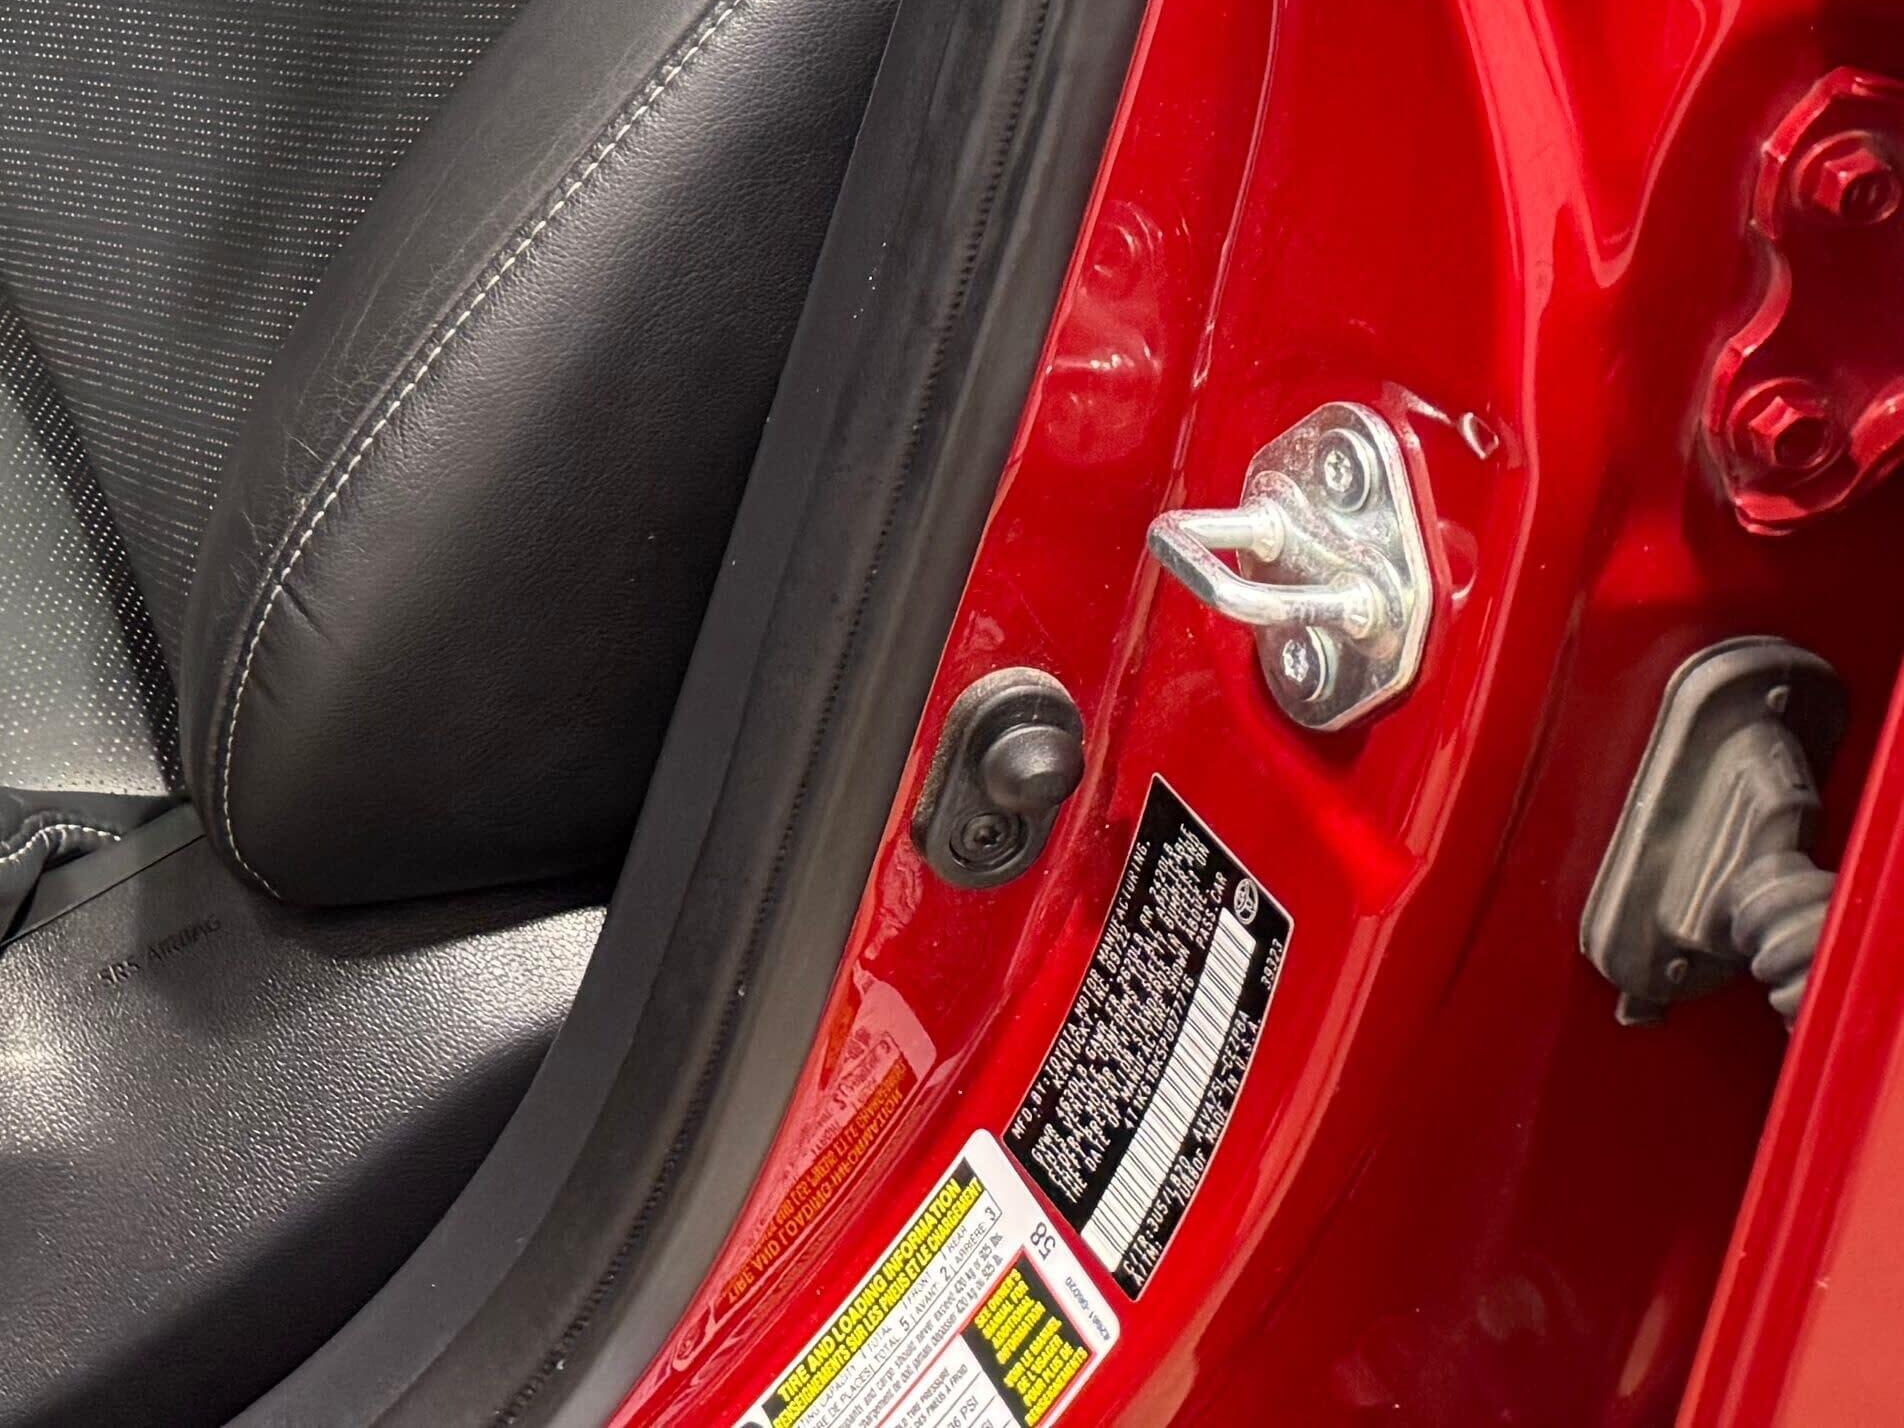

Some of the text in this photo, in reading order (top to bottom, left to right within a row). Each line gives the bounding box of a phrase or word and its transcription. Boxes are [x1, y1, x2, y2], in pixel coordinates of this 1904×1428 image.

[1074, 965, 1100, 1020] MOTOR
[1260, 936, 1283, 991] 39323
[1040, 822, 1191, 1173] THIS VEHICLE CONFORMS TO ALL APPLICABLE
[1058, 1144, 1087, 1195] THEFT
[1083, 1048, 1135, 1143] PREVENTION
[1131, 959, 1171, 1048] STANDARDS
[1166, 931, 1180, 956] IN
[1196, 842, 1209, 867] ON
[1030, 1120, 1056, 1164] GVWR
[1084, 1018, 1108, 1062] GAWR
[1104, 991, 1119, 1017] FR
[1139, 903, 1153, 928] RR
[1048, 995, 1144, 1185] FEDERAL MOTOR VEHICLE
[1066, 1173, 1087, 1206] THE
[1085, 1130, 1110, 1173] DATE
[1107, 1103, 1123, 1129] OF
[1120, 997, 1170, 1104] MANUFACTURE
[1165, 942, 1190, 994] SHOWN
[1205, 1100, 1229, 1144] MADE
[1224, 1072, 1239, 1096] IN
[843, 1322, 870, 1352] SUR
[861, 1303, 885, 1331] LES
[878, 1271, 911, 1311] PNEUS
[903, 1257, 922, 1280] ET
[914, 1243, 933, 1265] LE
[925, 1176, 984, 1252] CHARGEMENT
[897, 1315, 912, 1332] 5
[938, 1265, 952, 1281] 2
[984, 1205, 998, 1222] 3
[1027, 1219, 1059, 1260] 58
[776, 1363, 812, 1402] TIRE
[802, 1333, 838, 1373] AND
[829, 1272, 888, 1343] LOADING
[880, 1177, 962, 1281] INFORMATION
[973, 1304, 992, 1329] SEE
[990, 1292, 1035, 1349] ADDITIONAL
[1008, 1278, 1030, 1304] FOR
[994, 1300, 1046, 1365] INFORMATION
[1019, 1349, 1034, 1366] LE
[1040, 1354, 1064, 1383] PLUS
[958, 1394, 979, 1419] PSI
